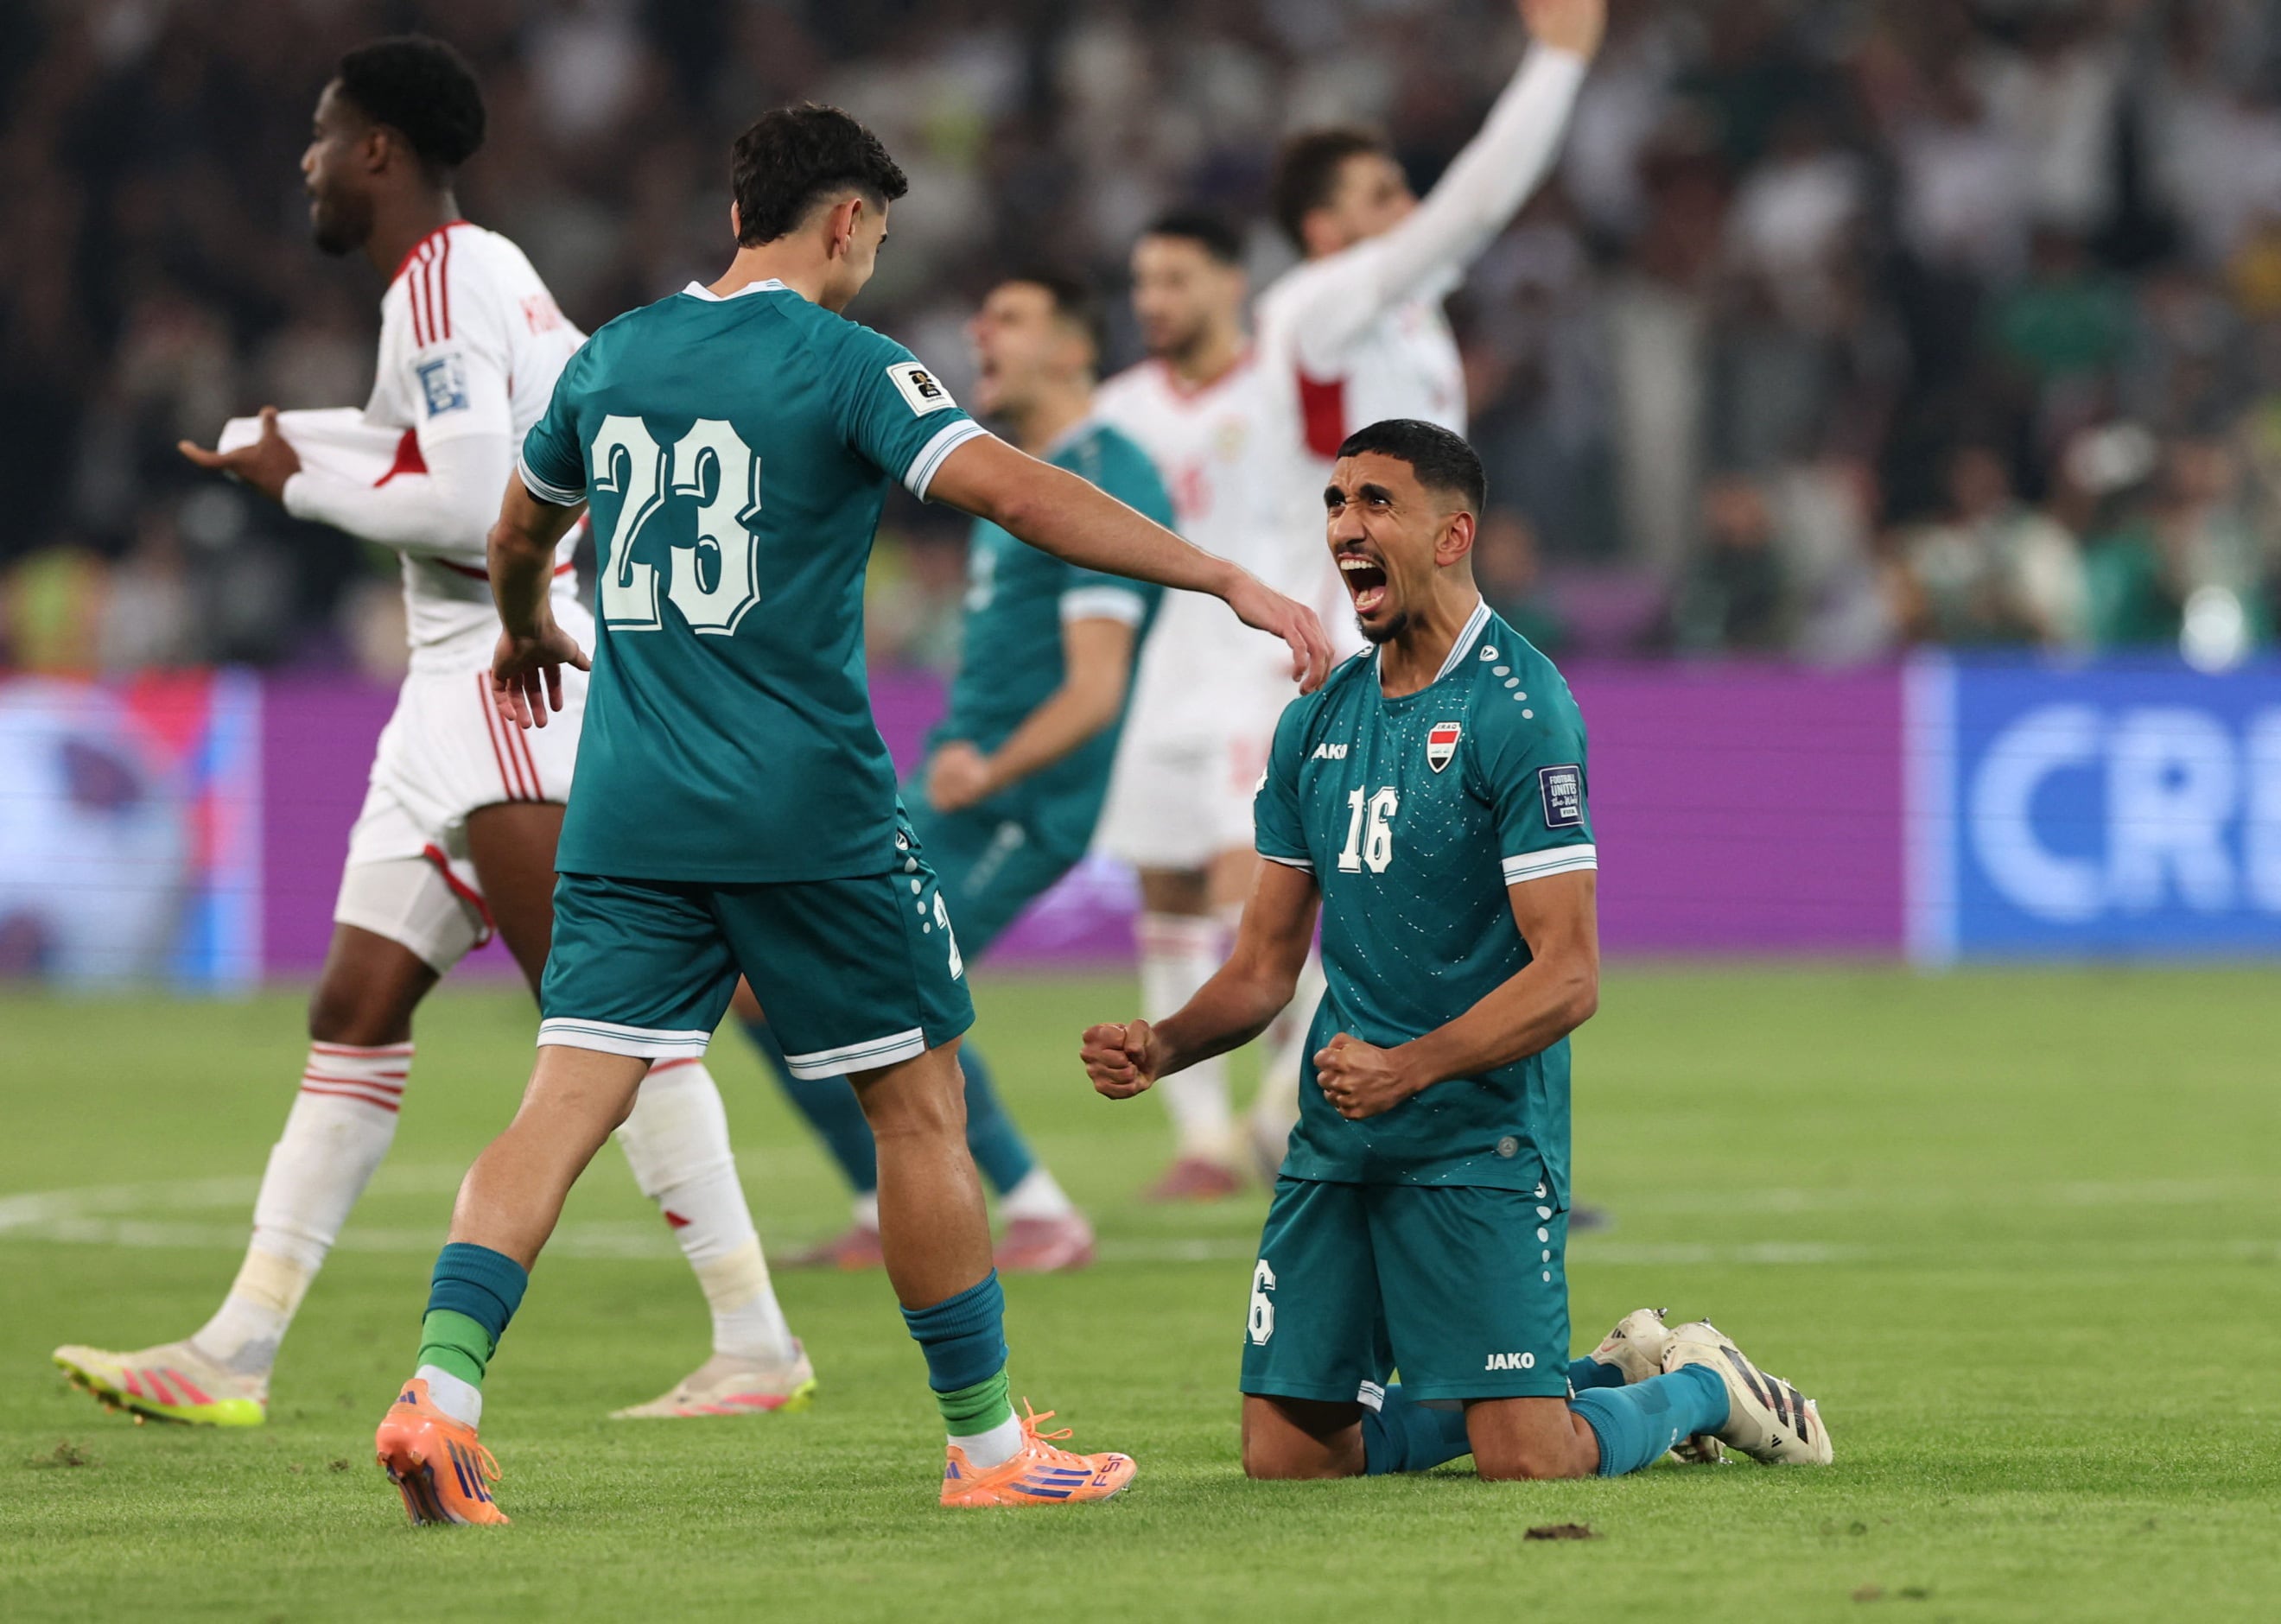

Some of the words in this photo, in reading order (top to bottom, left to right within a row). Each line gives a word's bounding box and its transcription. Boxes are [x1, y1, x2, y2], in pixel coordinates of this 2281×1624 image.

[591, 413, 761, 637] 23
[1312, 743, 1348, 759] AKO
[1548, 773, 1577, 785] FOOTBALL
[1337, 784, 1399, 874] 16
[1244, 1258, 1276, 1346] 6
[1484, 1351, 1535, 1371] JAKO
